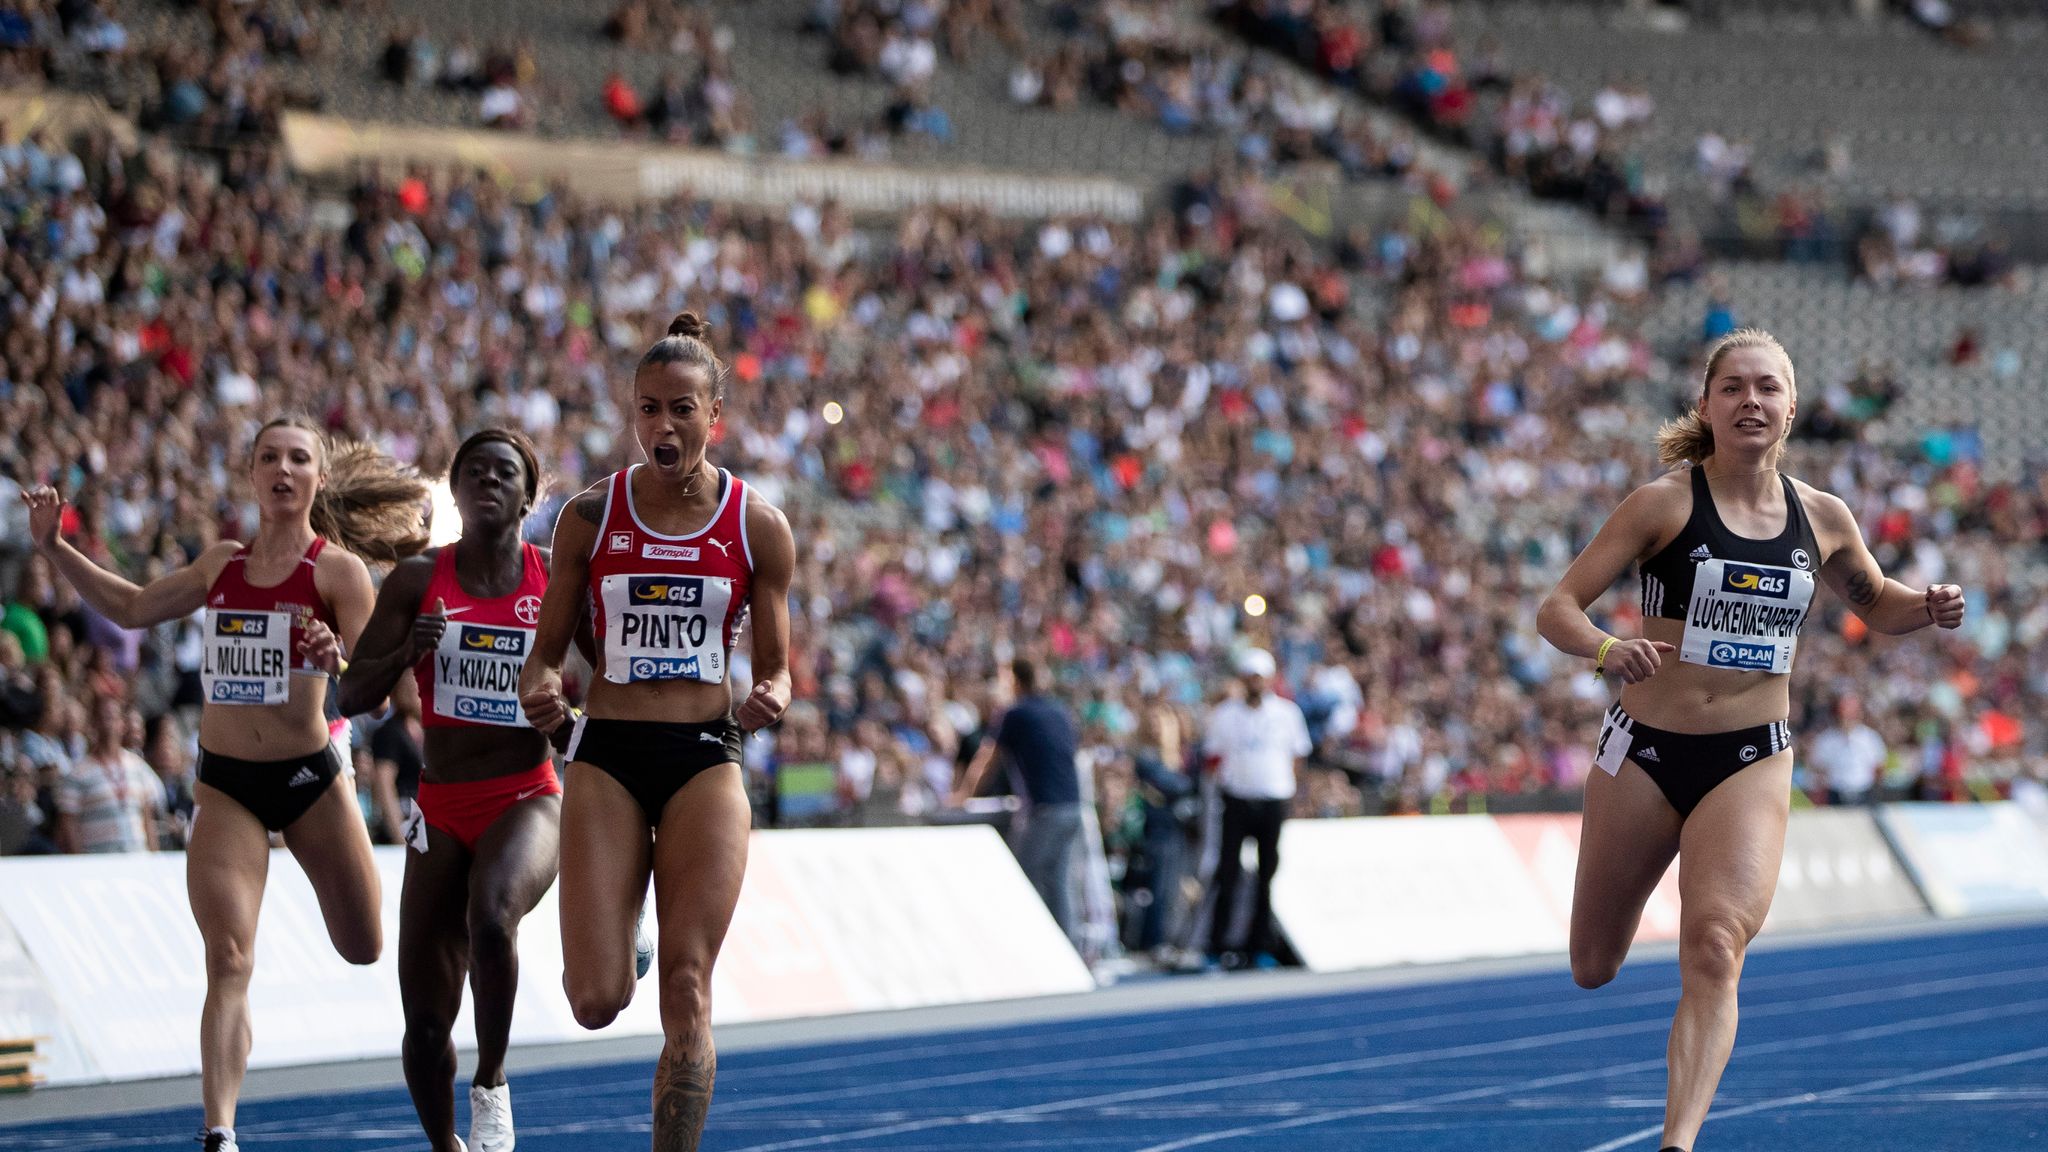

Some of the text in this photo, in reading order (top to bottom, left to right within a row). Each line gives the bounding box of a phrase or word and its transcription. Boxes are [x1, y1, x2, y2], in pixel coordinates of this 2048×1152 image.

[648, 546, 694, 558] Kornspitz
[1758, 576, 1785, 593] GLS
[667, 586, 697, 602] GLS
[1692, 589, 1801, 637] LÜCKENKEMPER
[243, 620, 264, 634] GLS
[621, 612, 707, 649] PINTO
[494, 635, 520, 651] GLS
[217, 636, 284, 678] MÜLLER
[710, 652, 719, 669] 829
[1738, 647, 1773, 662] PLAN
[440, 655, 453, 686] Y.
[659, 661, 697, 674] PLAN
[231, 682, 263, 696] PLAN
[480, 701, 516, 716] PLAN
